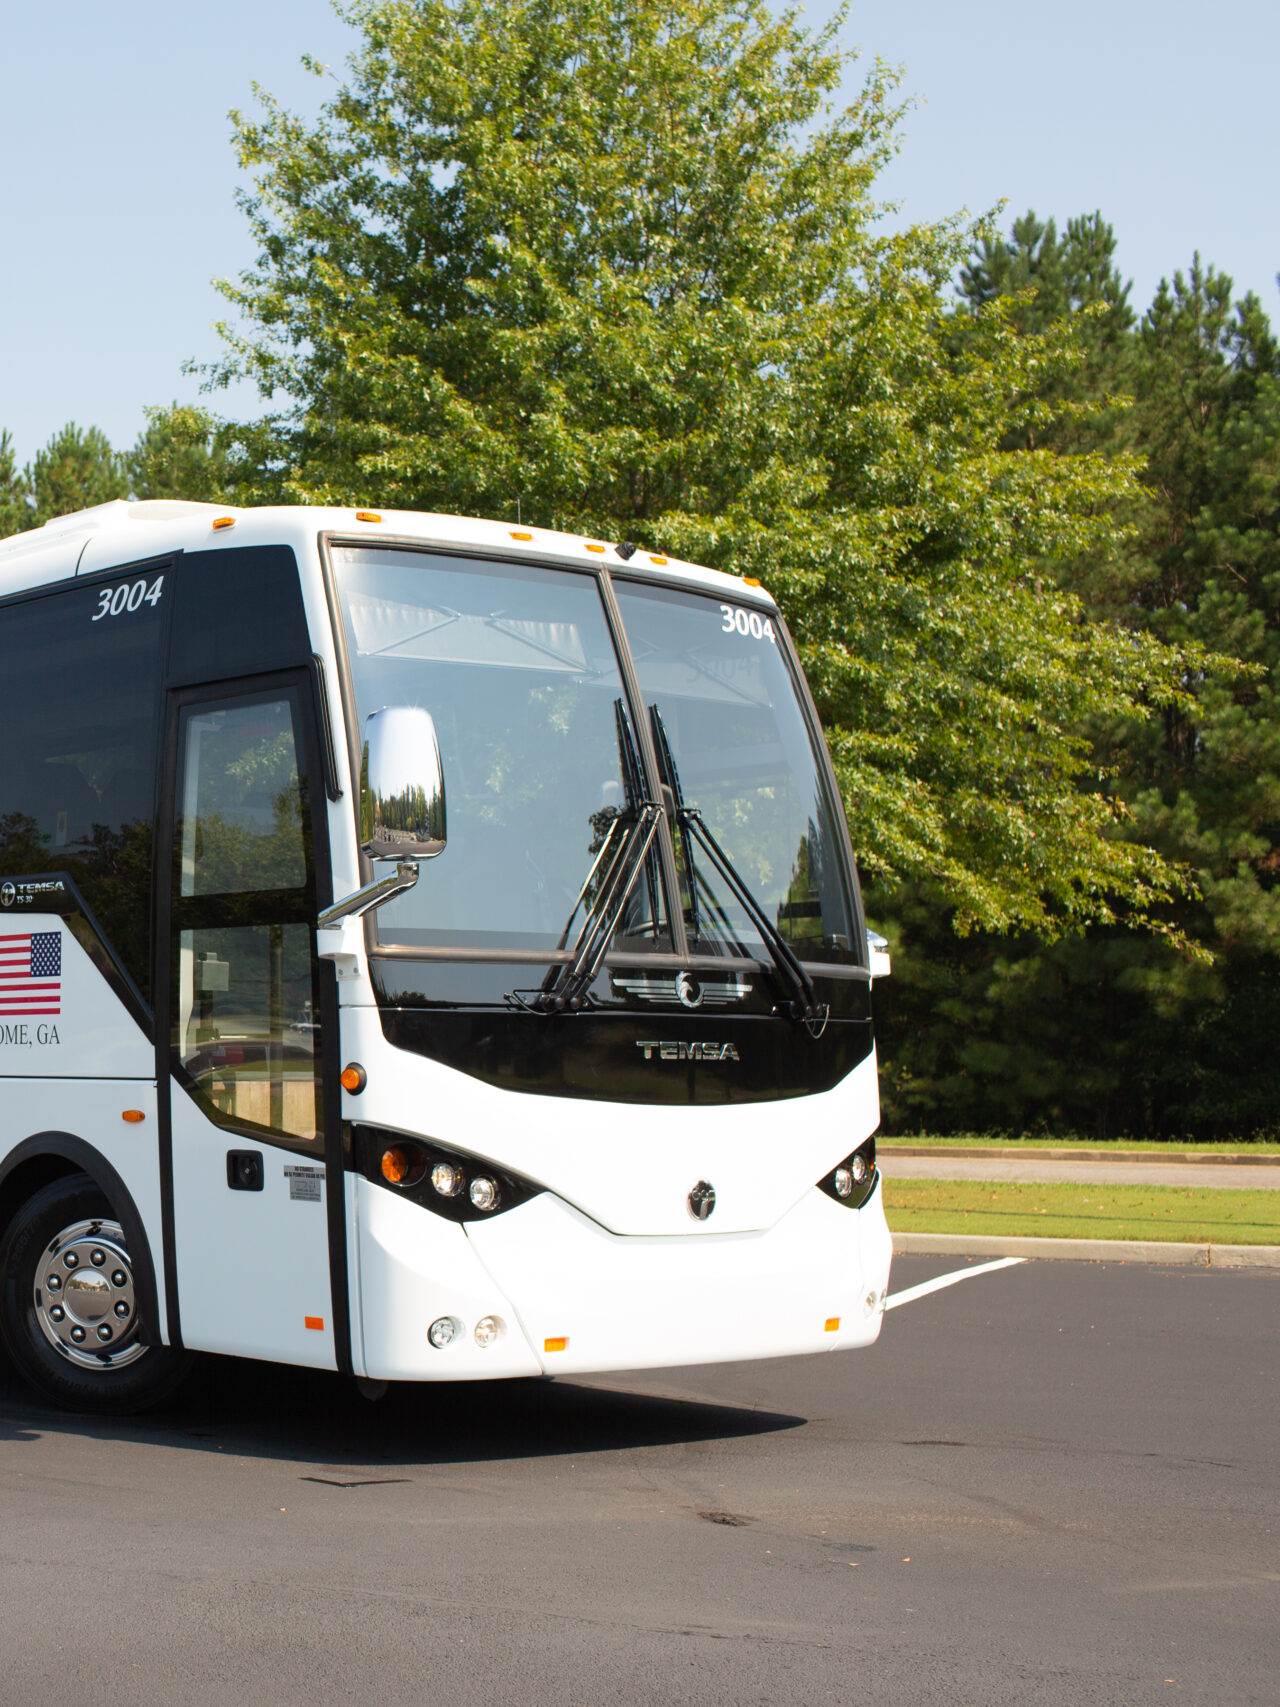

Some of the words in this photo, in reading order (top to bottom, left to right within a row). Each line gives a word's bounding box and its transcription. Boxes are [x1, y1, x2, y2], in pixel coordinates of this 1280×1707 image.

[91, 575, 165, 621] 3004
[719, 604, 776, 644] 3004
[16, 880, 65, 894] TEMSA
[36, 1023, 61, 1045] GA
[635, 1040, 741, 1061] TEMSA
